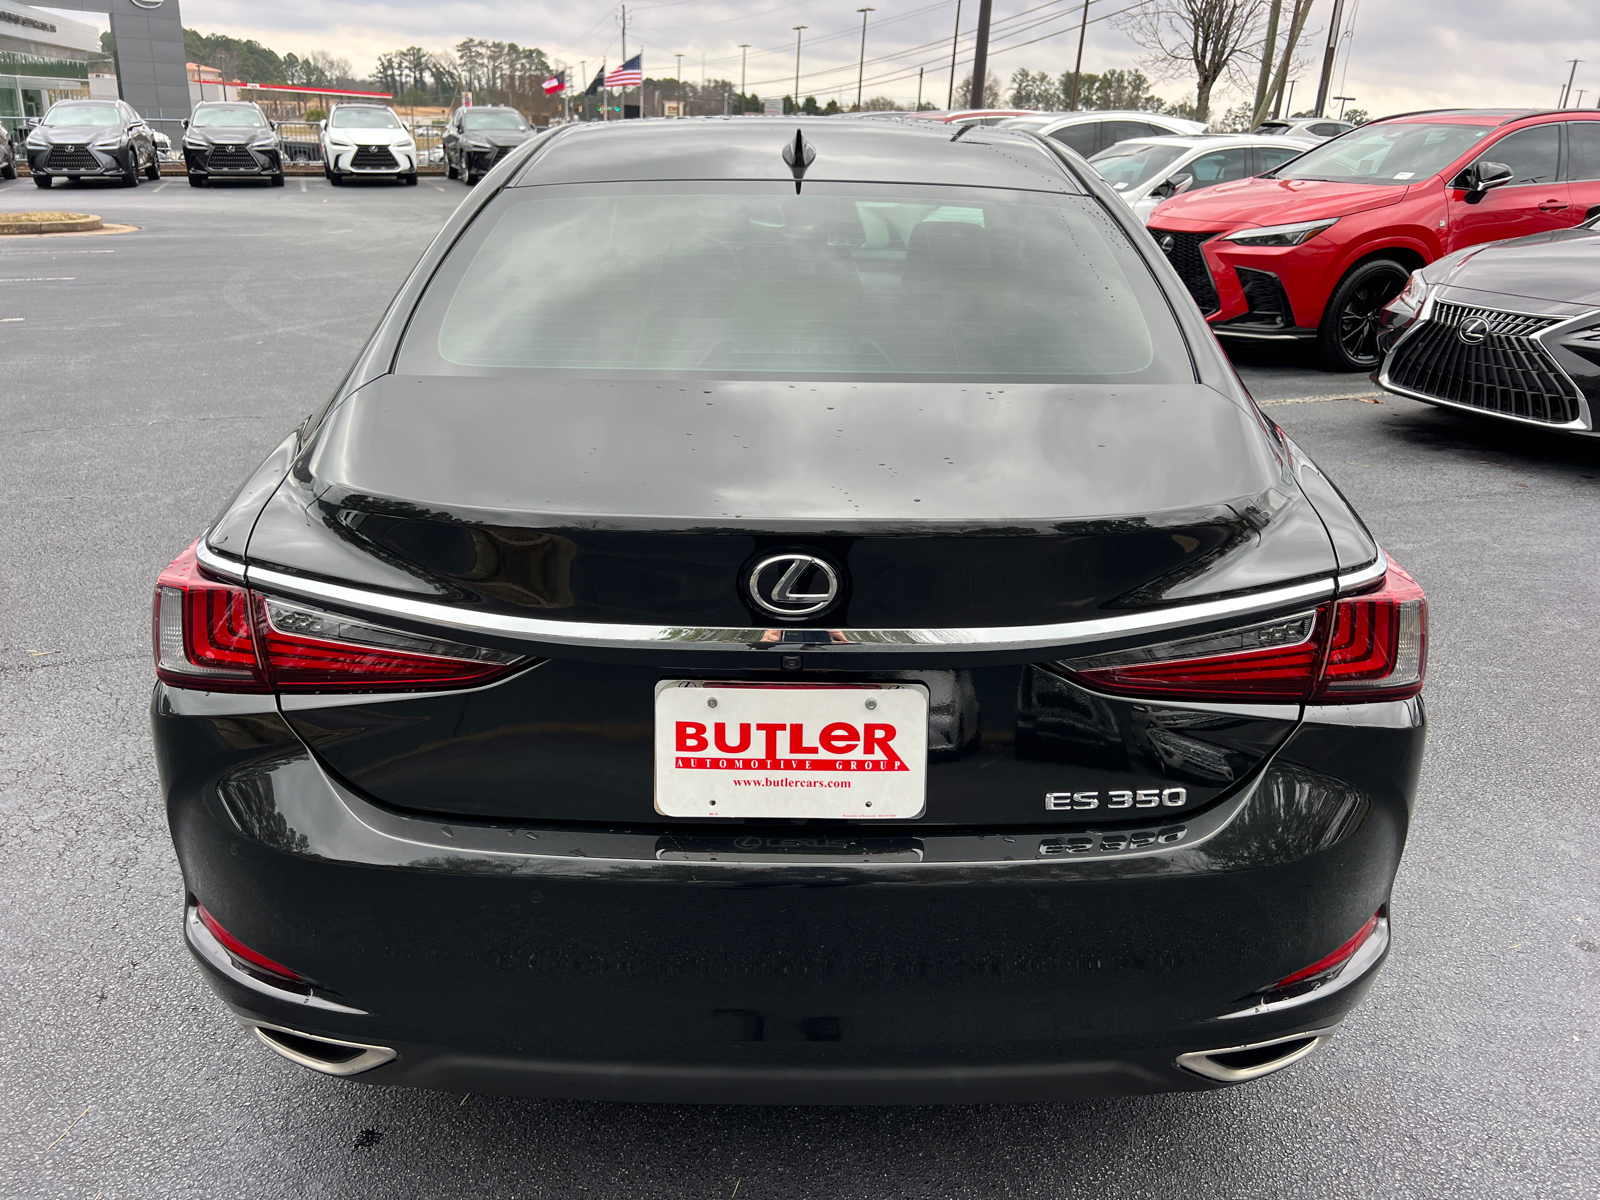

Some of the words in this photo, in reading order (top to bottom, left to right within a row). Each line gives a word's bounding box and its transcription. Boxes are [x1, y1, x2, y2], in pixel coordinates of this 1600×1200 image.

[676, 758, 812, 770] AUTOMOTIVE
[836, 760, 902, 771] GROUP
[733, 778, 851, 789] www.butlercars.com
[1045, 791, 1099, 811] ES
[1107, 787, 1187, 809] 350
